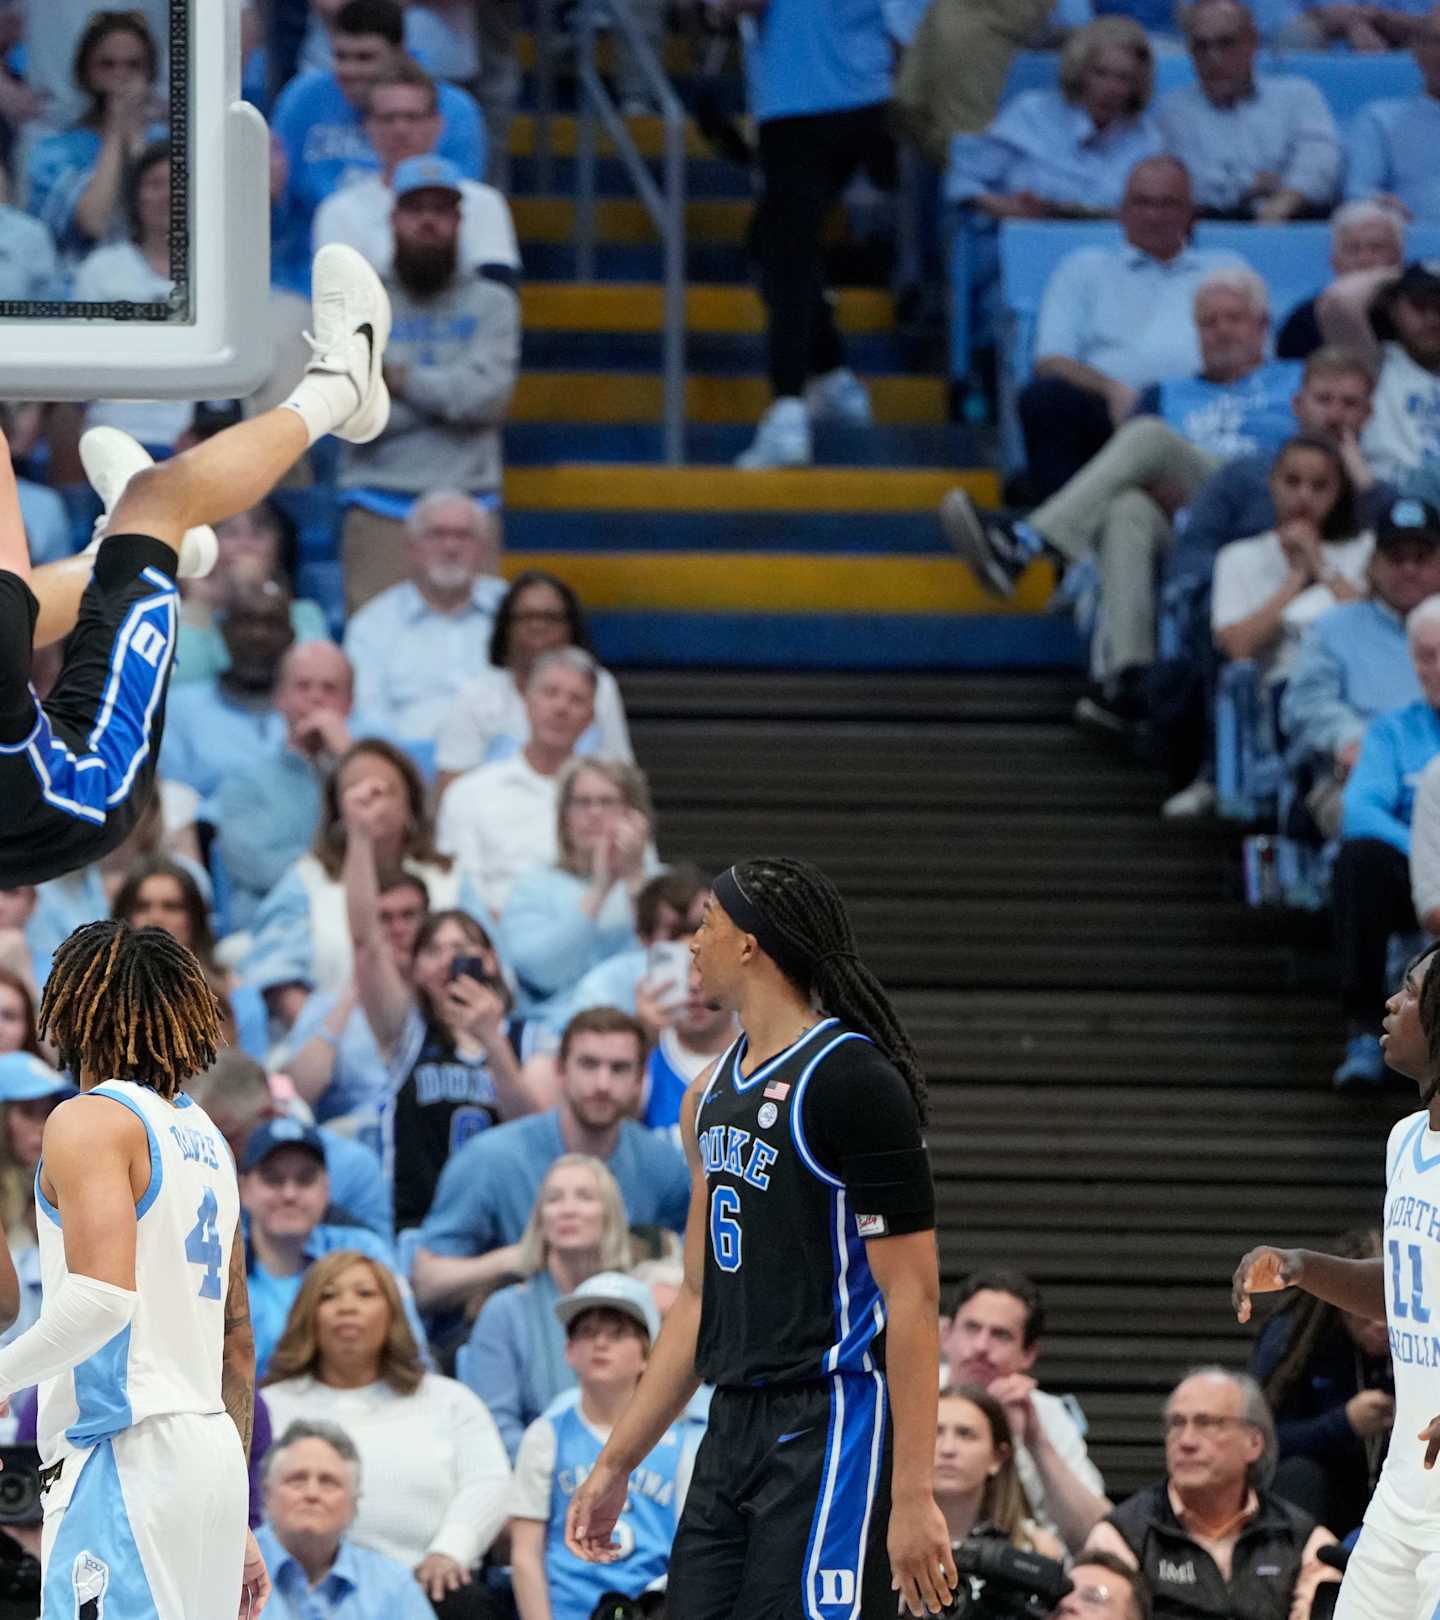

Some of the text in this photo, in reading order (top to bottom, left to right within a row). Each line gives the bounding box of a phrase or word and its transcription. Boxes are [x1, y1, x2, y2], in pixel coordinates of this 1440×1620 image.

[415, 1064, 496, 1107] DUK
[699, 1125, 779, 1191] DUKE
[184, 1185, 222, 1300] 4
[710, 1184, 742, 1273] 6
[1388, 1240, 1431, 1324] 11
